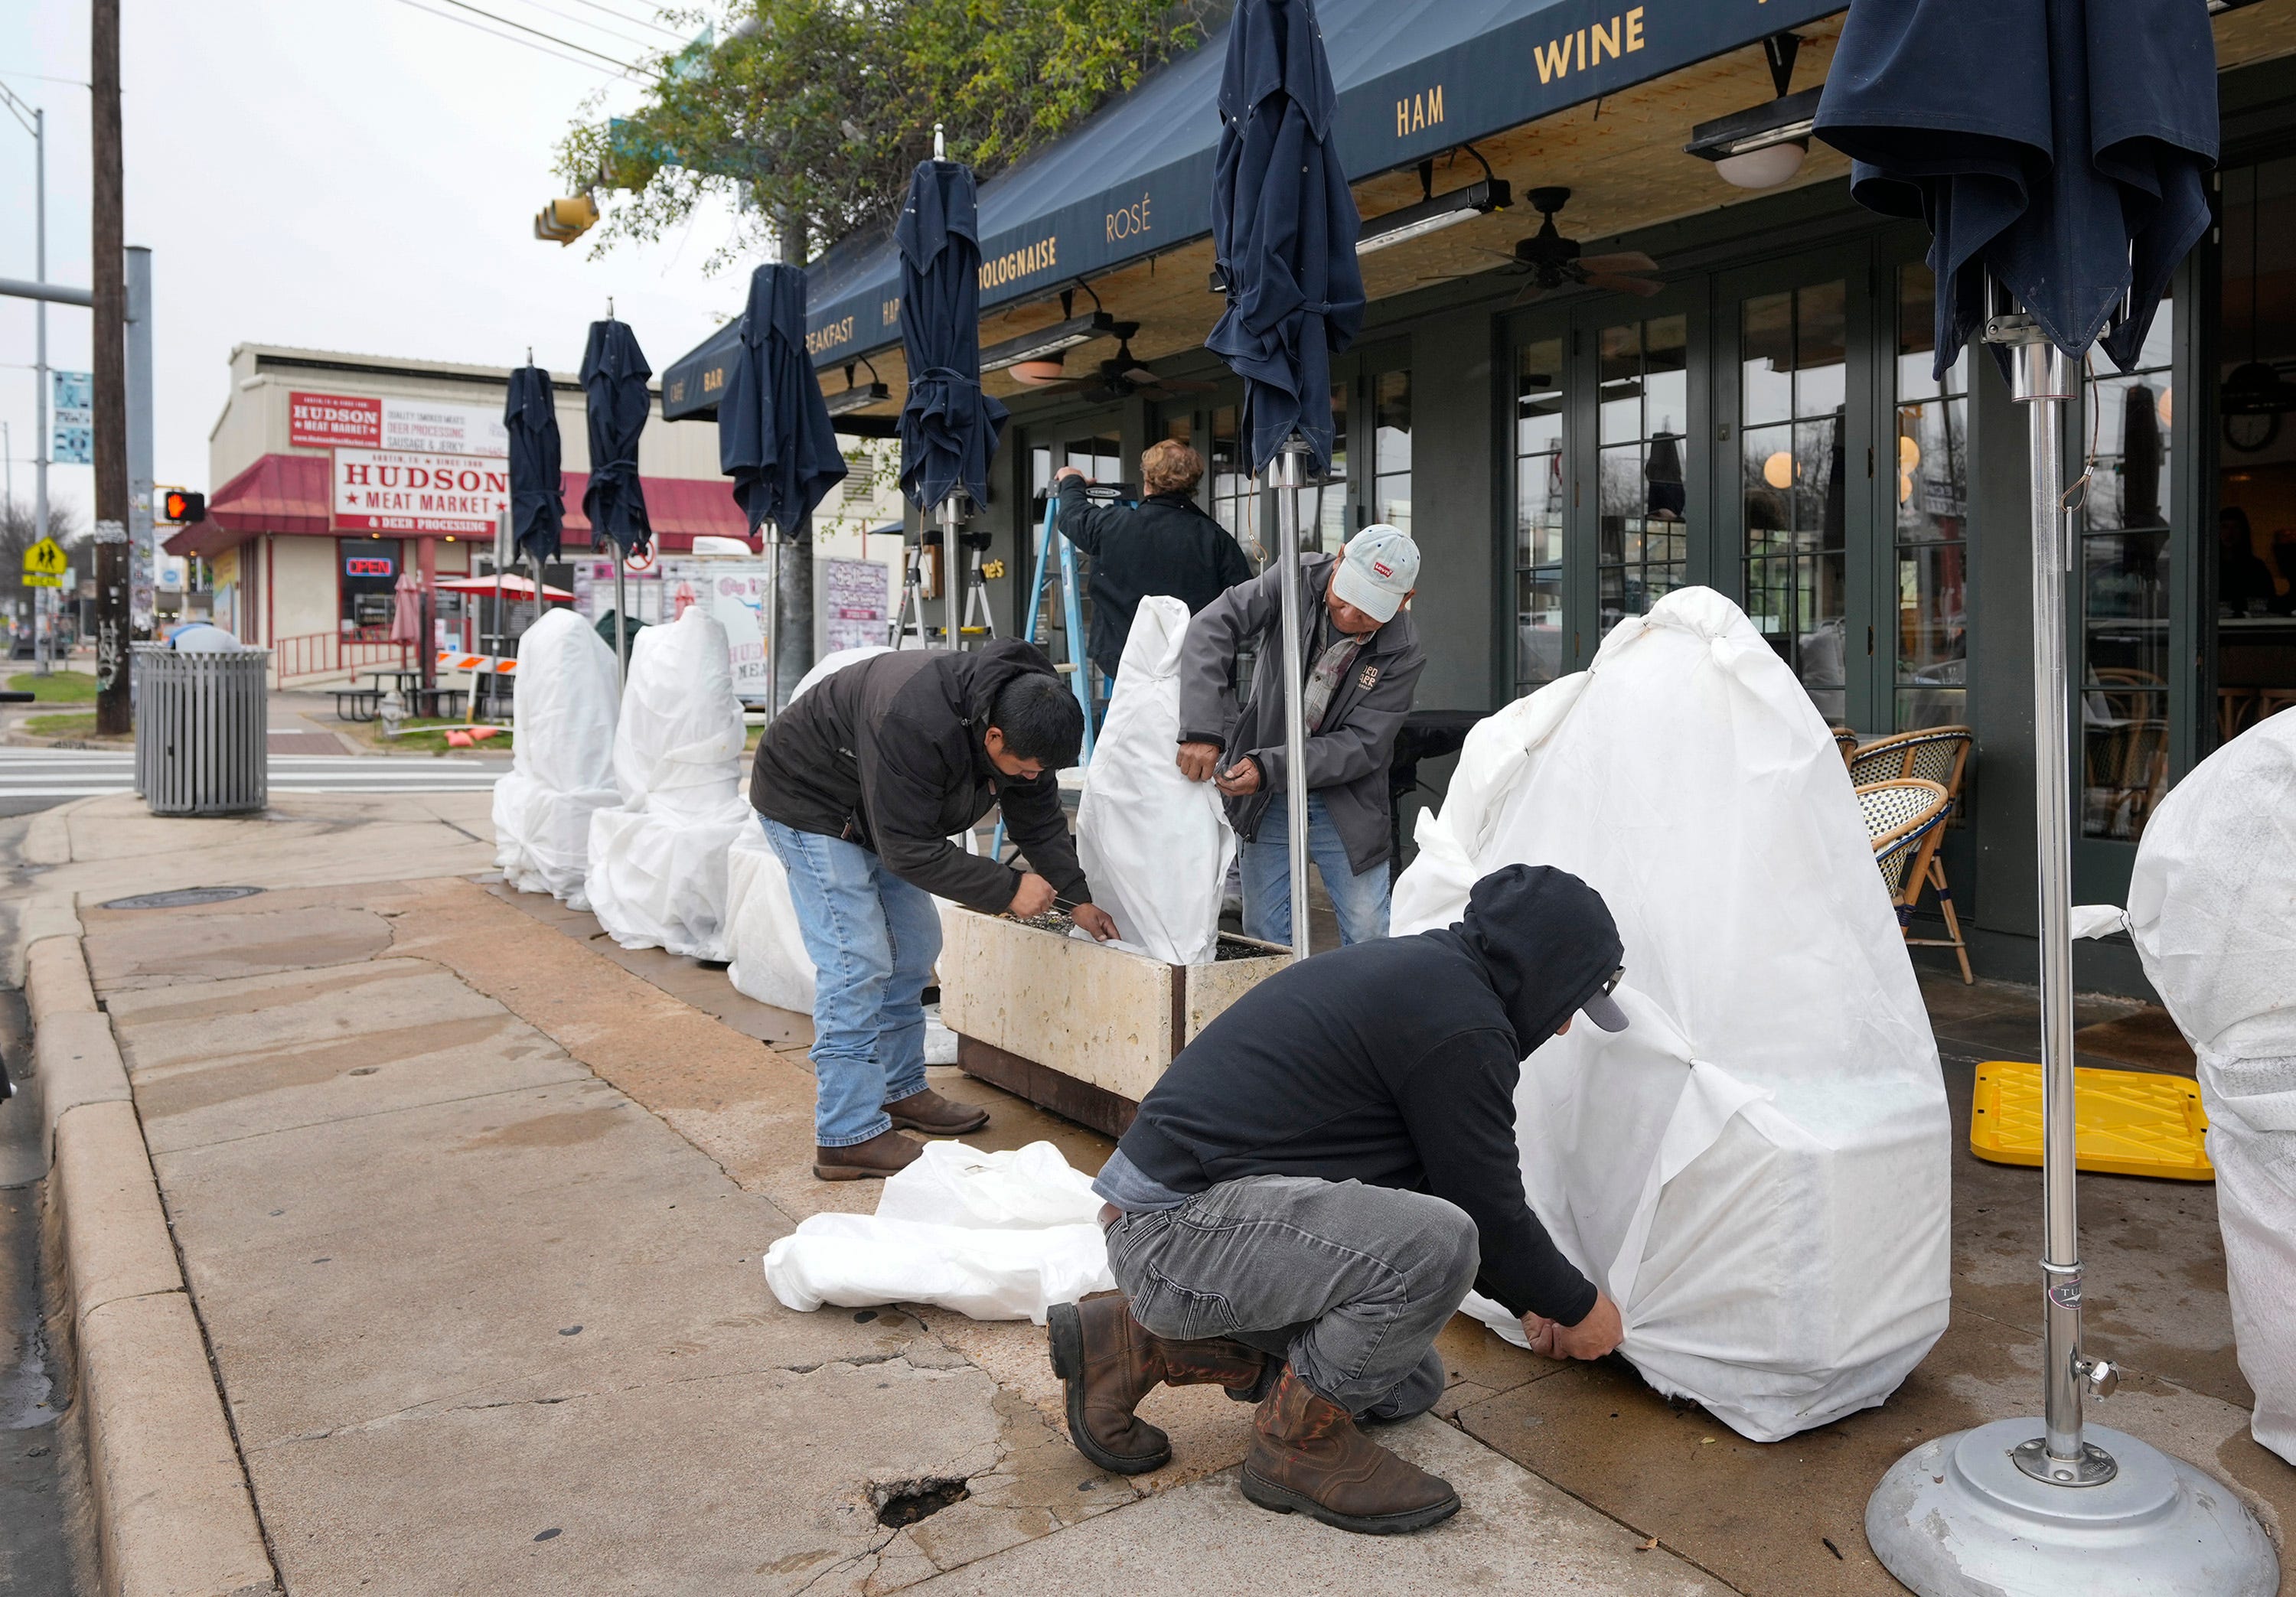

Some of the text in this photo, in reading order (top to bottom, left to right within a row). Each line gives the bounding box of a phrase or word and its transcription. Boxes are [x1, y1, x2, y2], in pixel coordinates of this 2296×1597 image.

[1533, 5, 1645, 85] WINE
[1397, 84, 1443, 138] HAM
[1106, 191, 1151, 243] ROSÉ
[704, 367, 722, 392] BAR
[293, 405, 378, 425] HUDSON
[304, 420, 368, 435] MEAT MARKET
[387, 422, 464, 438] DEER PROCESSING
[387, 436, 422, 451] SAUSAGE
[429, 441, 435, 451] &
[439, 442, 465, 455] JERKY
[344, 463, 509, 494] HUDSON
[367, 491, 491, 513] MEAT MARKET
[368, 517, 487, 532] & DEER PROCESSING
[348, 560, 391, 575] OPEN
